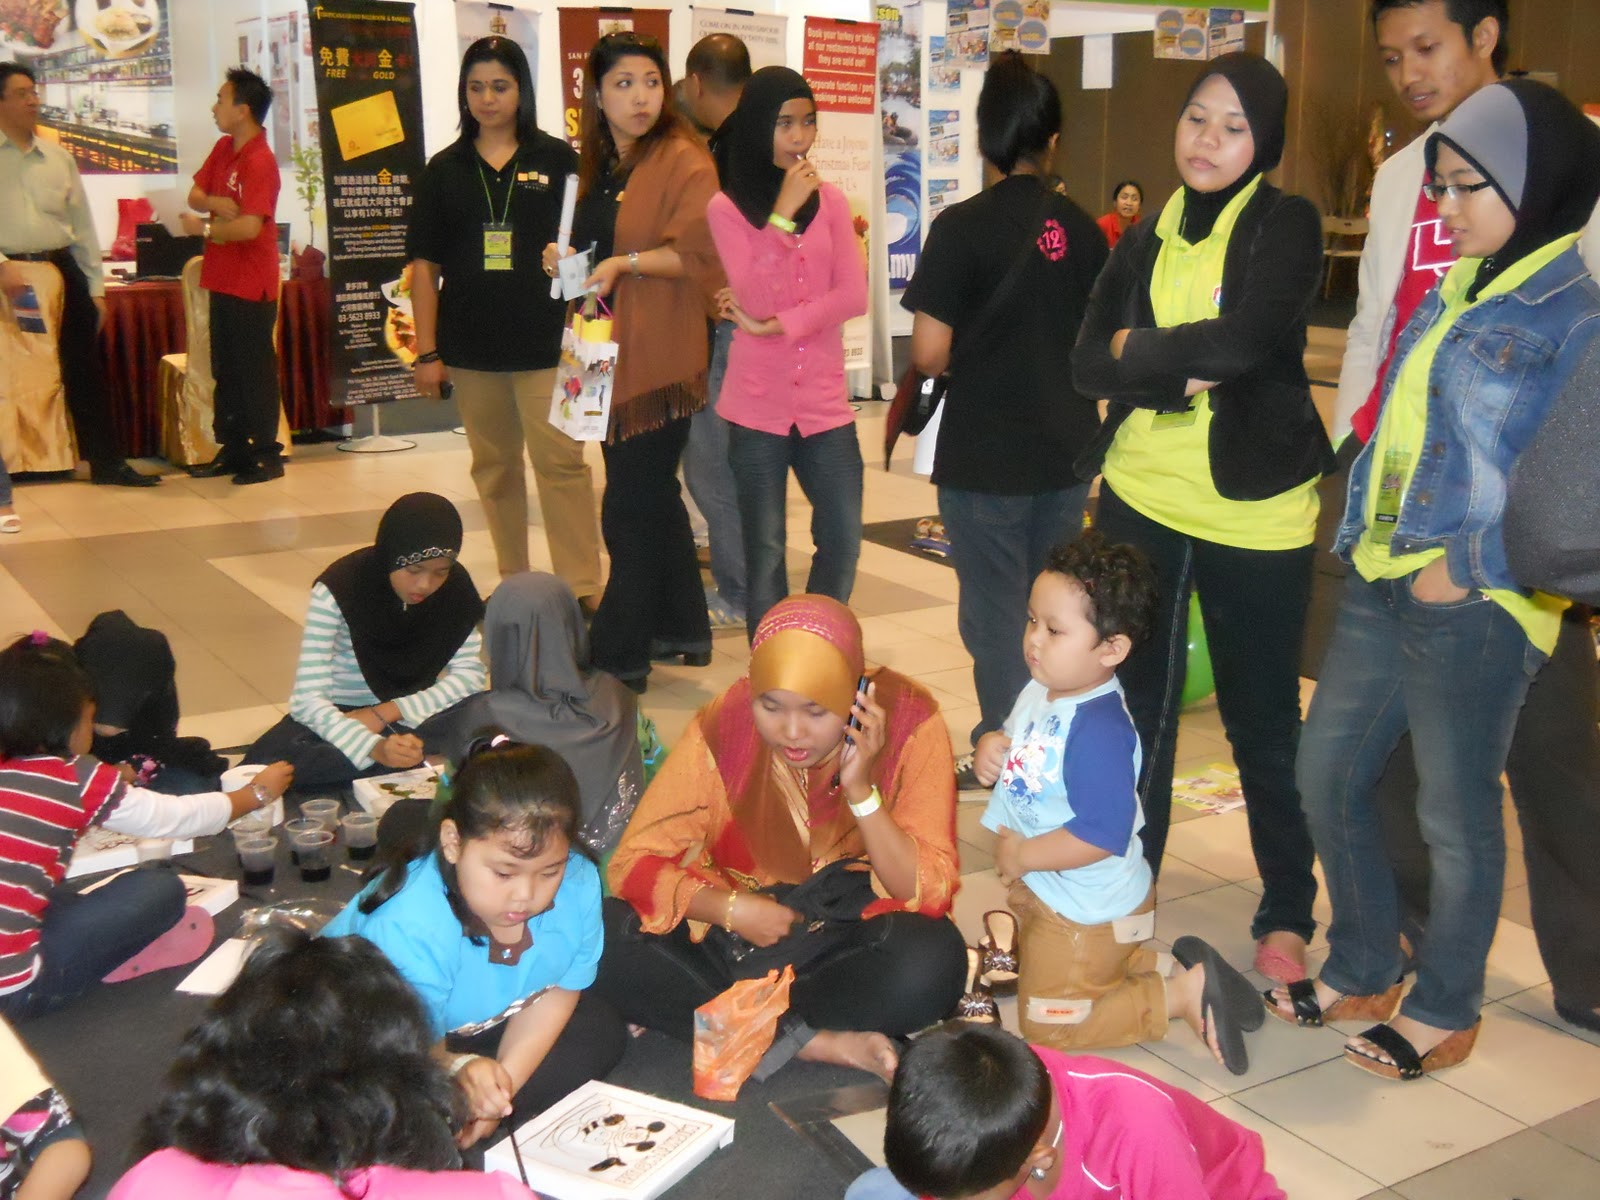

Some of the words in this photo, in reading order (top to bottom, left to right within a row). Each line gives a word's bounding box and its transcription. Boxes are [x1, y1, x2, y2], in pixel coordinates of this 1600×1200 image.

[807, 27, 823, 38] Book
[823, 30, 837, 41] your
[855, 34, 861, 42] or
[861, 34, 875, 43] table
[807, 41, 815, 50] at
[815, 42, 826, 51] our
[826, 43, 857, 54] restaurants
[858, 46, 875, 56] before
[818, 54, 831, 66] they
[831, 57, 841, 66] are
[842, 57, 854, 67] sold
[326, 68, 347, 79] FREE
[372, 71, 396, 80] GOLD
[836, 81, 858, 92] function
[837, 95, 847, 103] are
[847, 95, 872, 105] welcome
[1042, 229, 1062, 249] 12
